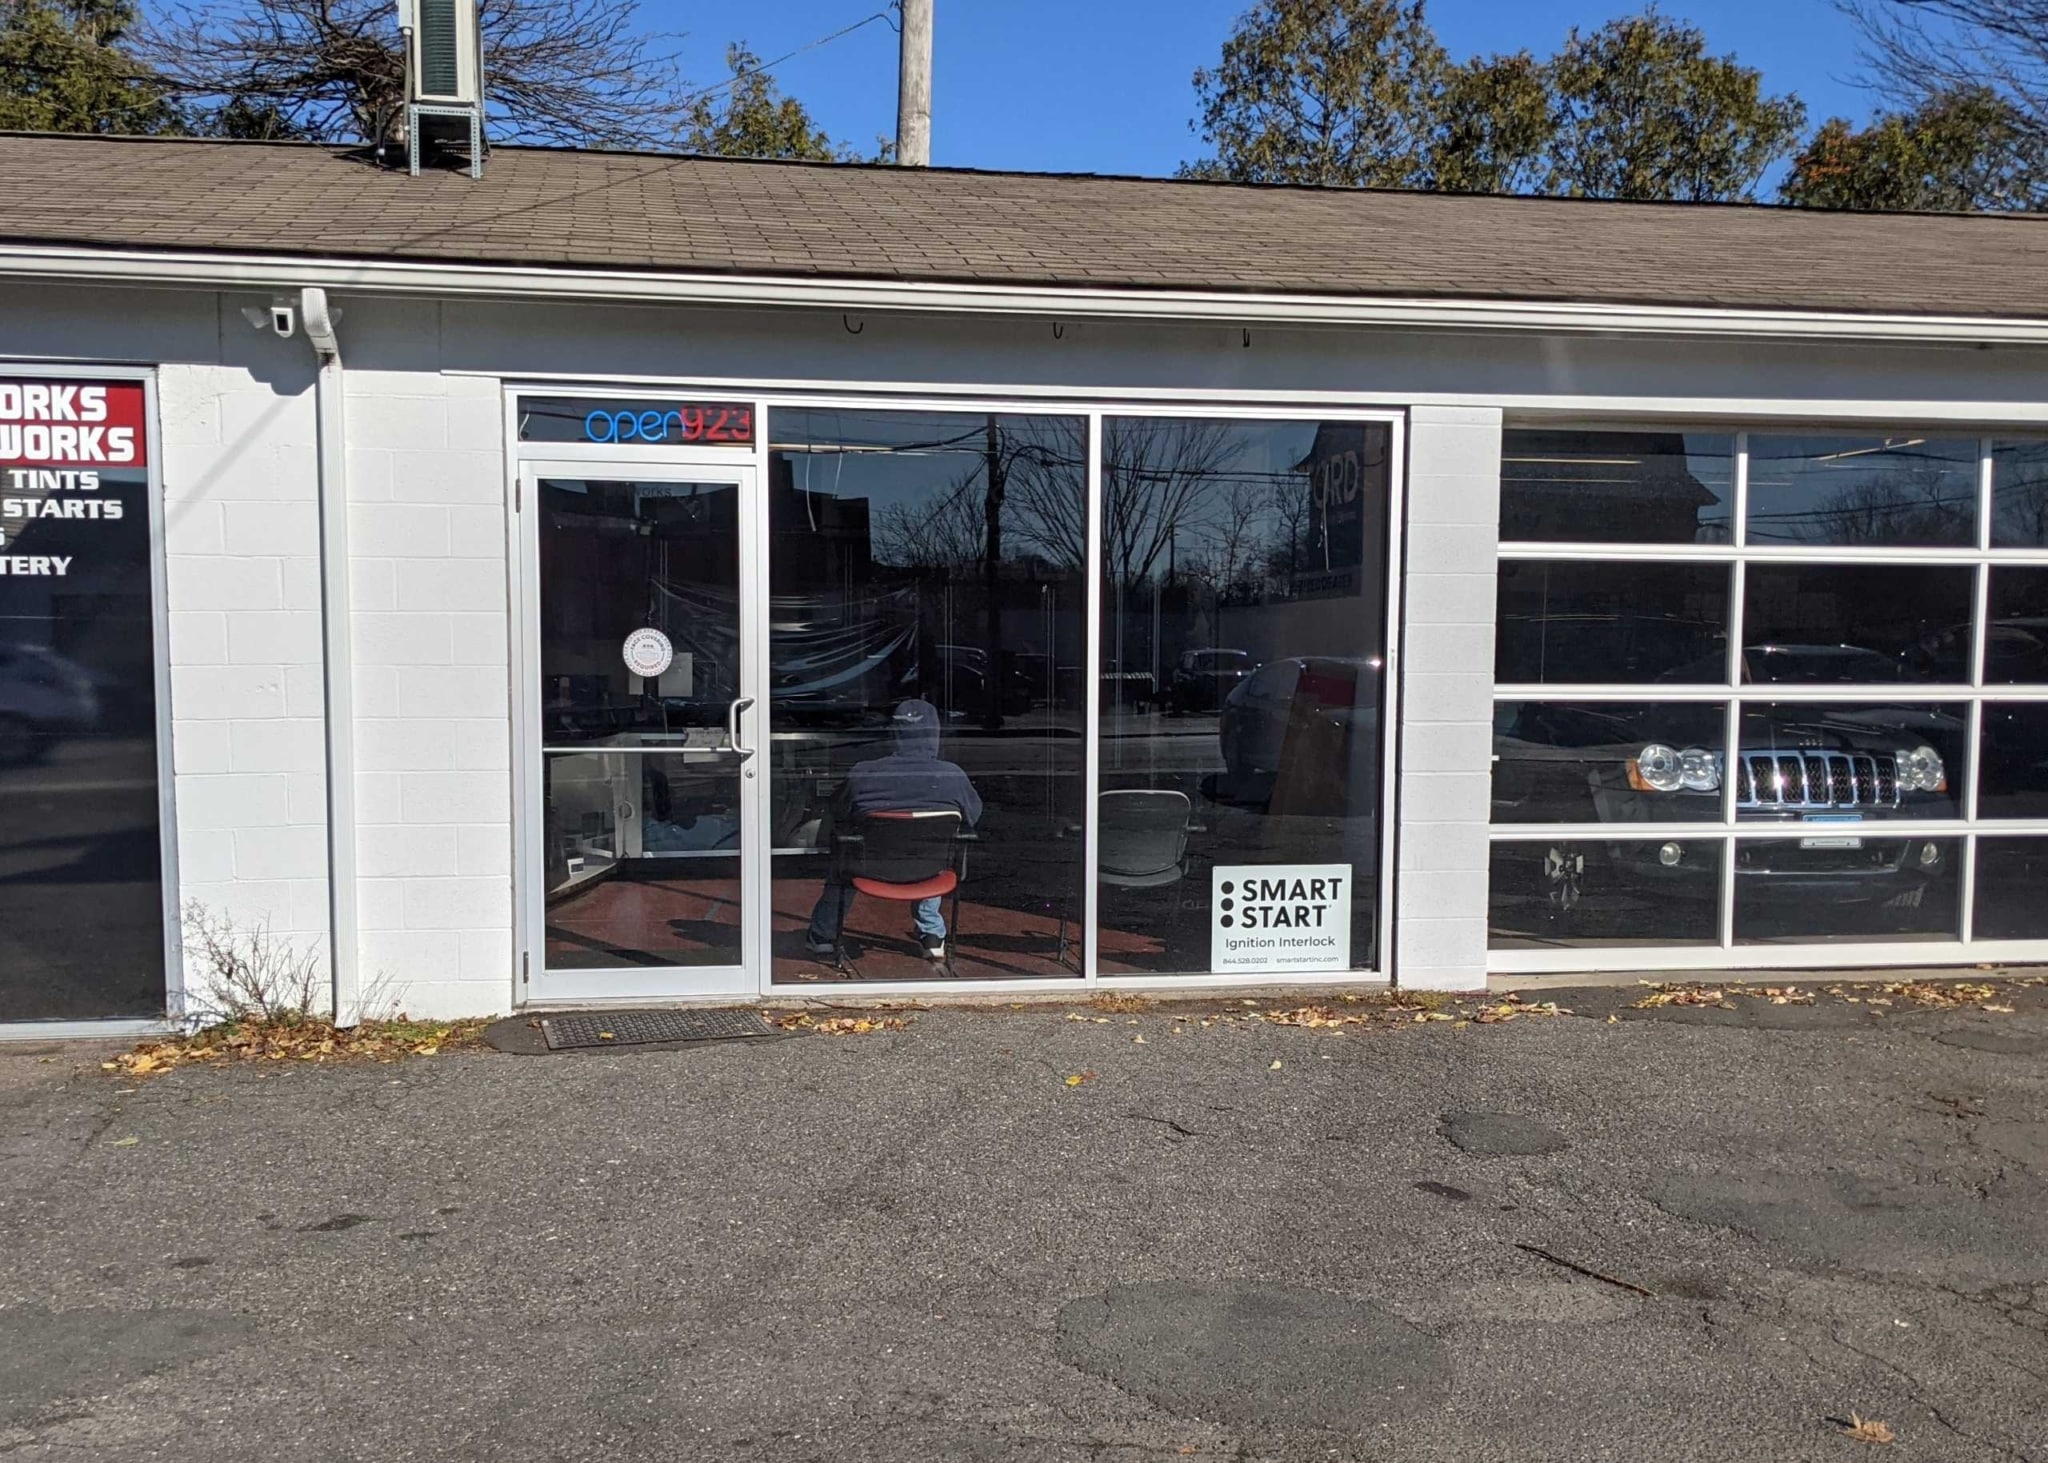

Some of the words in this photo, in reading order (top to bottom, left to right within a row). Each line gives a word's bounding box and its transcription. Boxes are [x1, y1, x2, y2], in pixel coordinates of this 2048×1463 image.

[8, 469, 99, 490] TINTS
[3, 498, 123, 519] STARTS
[1241, 878, 1343, 902] SMART
[1241, 905, 1327, 928] START
[1225, 937, 1275, 951] Ignition
[1279, 936, 1336, 947] Interlock
[1276, 956, 1339, 964] smartstartinc.com
